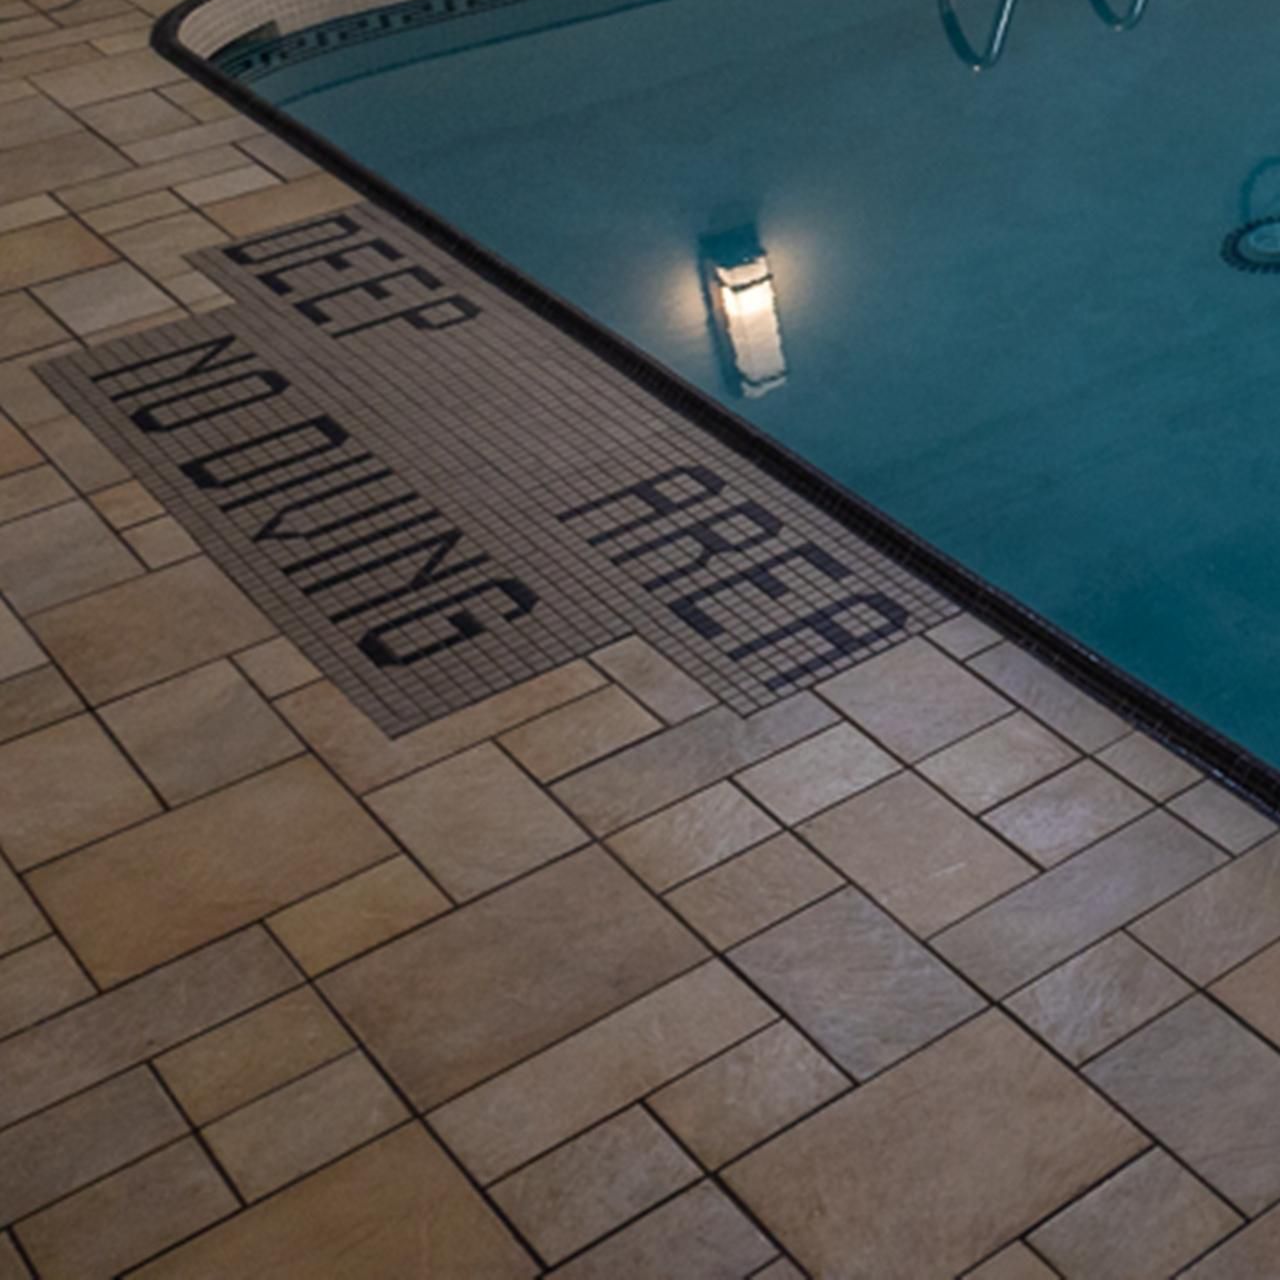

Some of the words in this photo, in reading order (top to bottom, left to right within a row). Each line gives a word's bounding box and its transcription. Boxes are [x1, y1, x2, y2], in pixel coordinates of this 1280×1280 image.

[91, 334, 290, 433] NO
[221, 214, 482, 339] DEEP
[555, 466, 909, 691] AREA
[179, 414, 540, 668] DIVING
